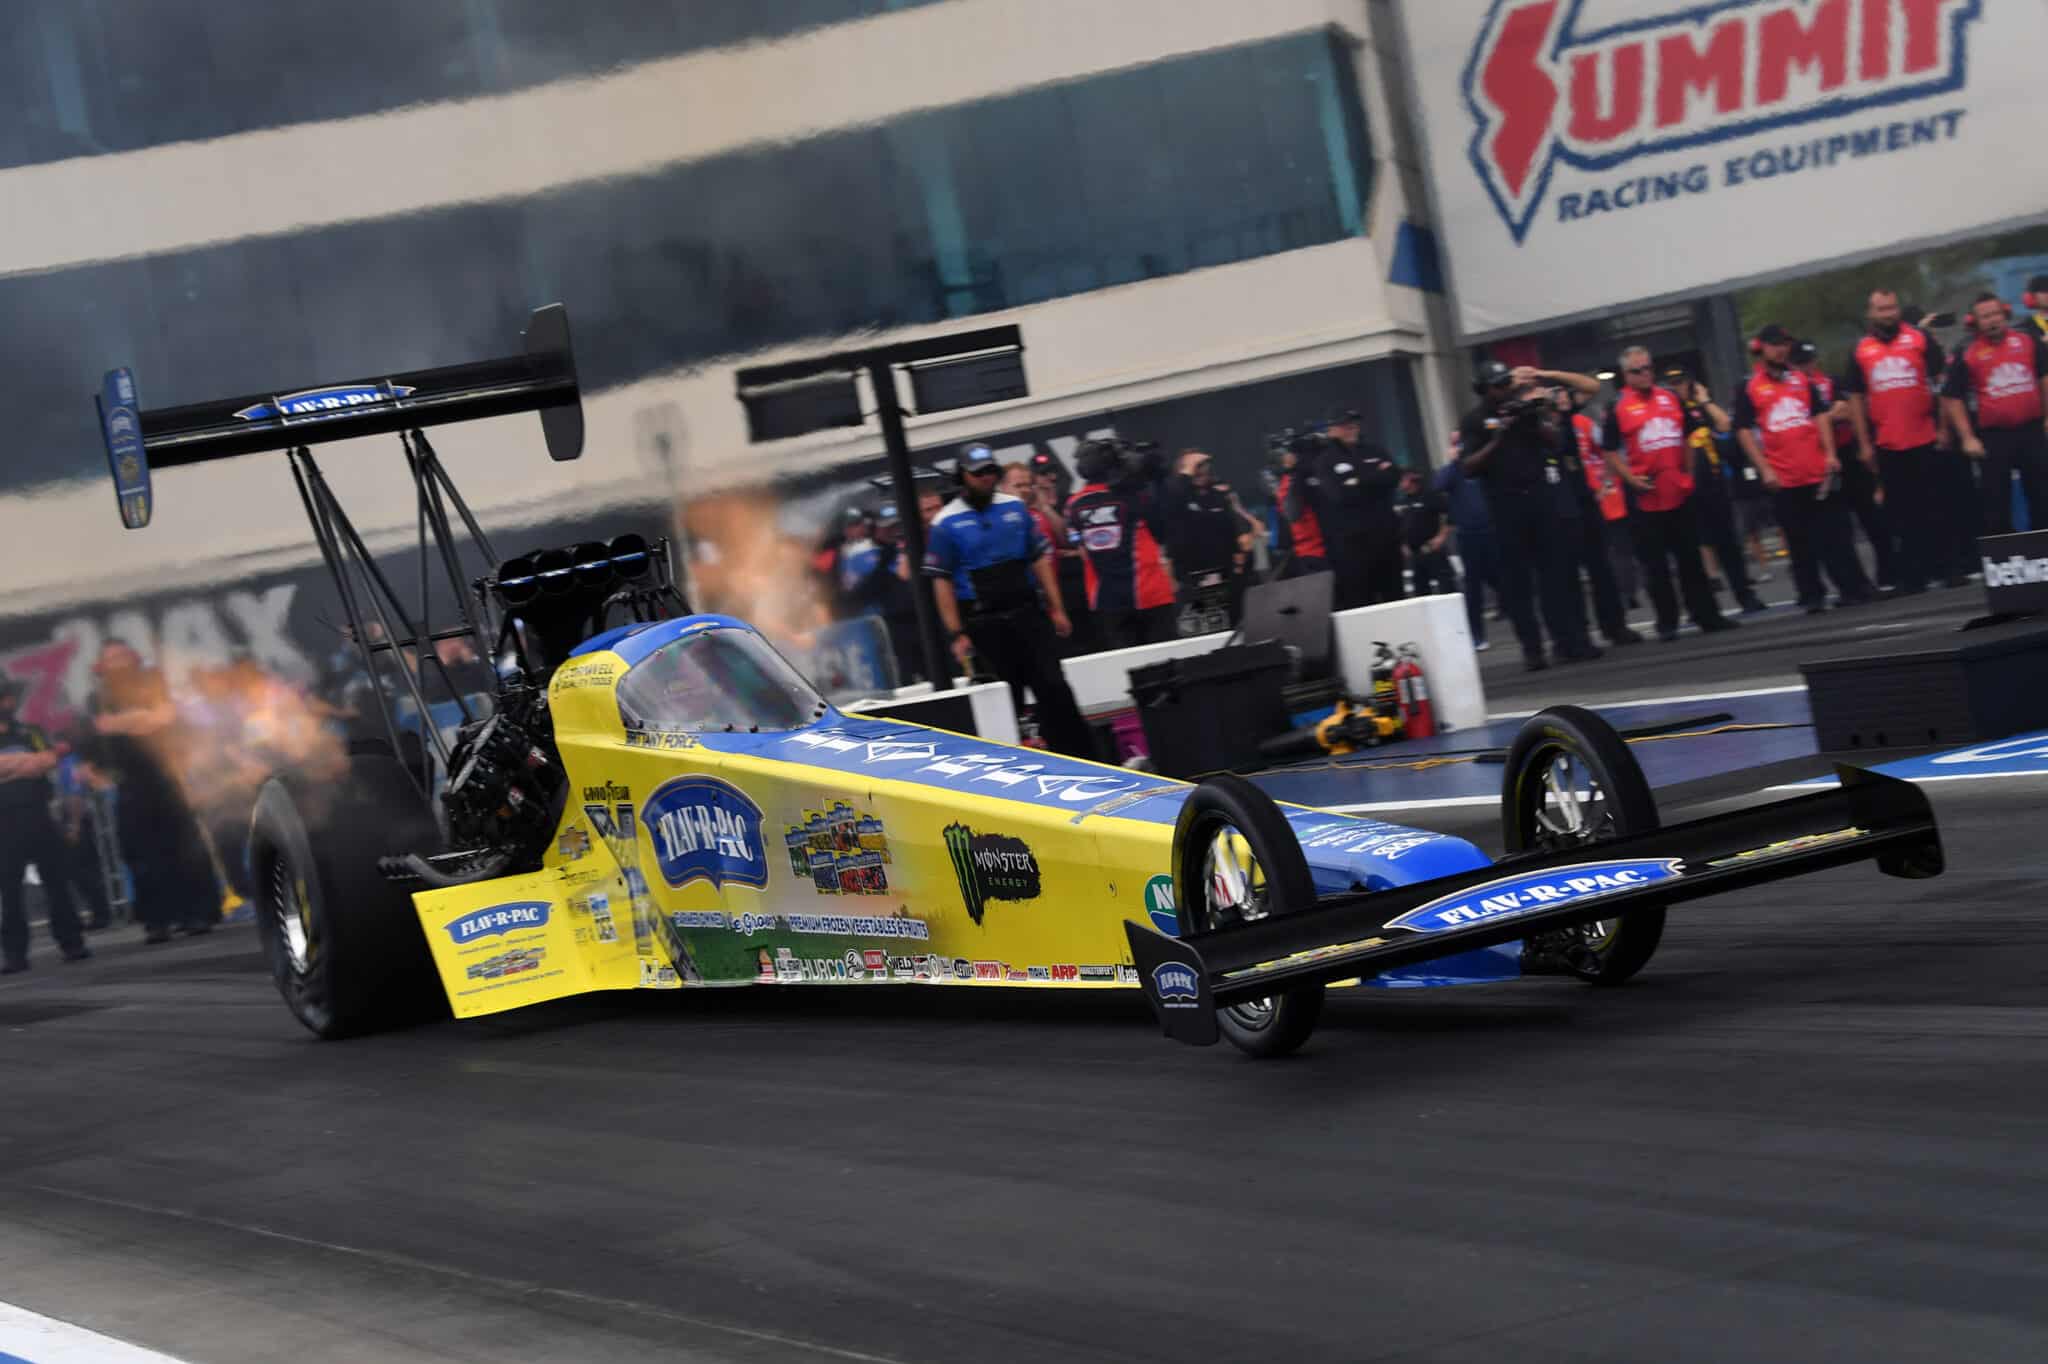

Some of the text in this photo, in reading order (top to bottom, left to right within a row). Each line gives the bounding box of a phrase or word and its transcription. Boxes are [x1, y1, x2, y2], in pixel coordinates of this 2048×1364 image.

[1481, 0, 1952, 199] SUMMIT
[1557, 109, 1968, 222] RACING EQUIPMENT
[973, 848, 1034, 873] MONSTER
[801, 959, 847, 980] HURCO
[1051, 964, 1078, 980] ARP
